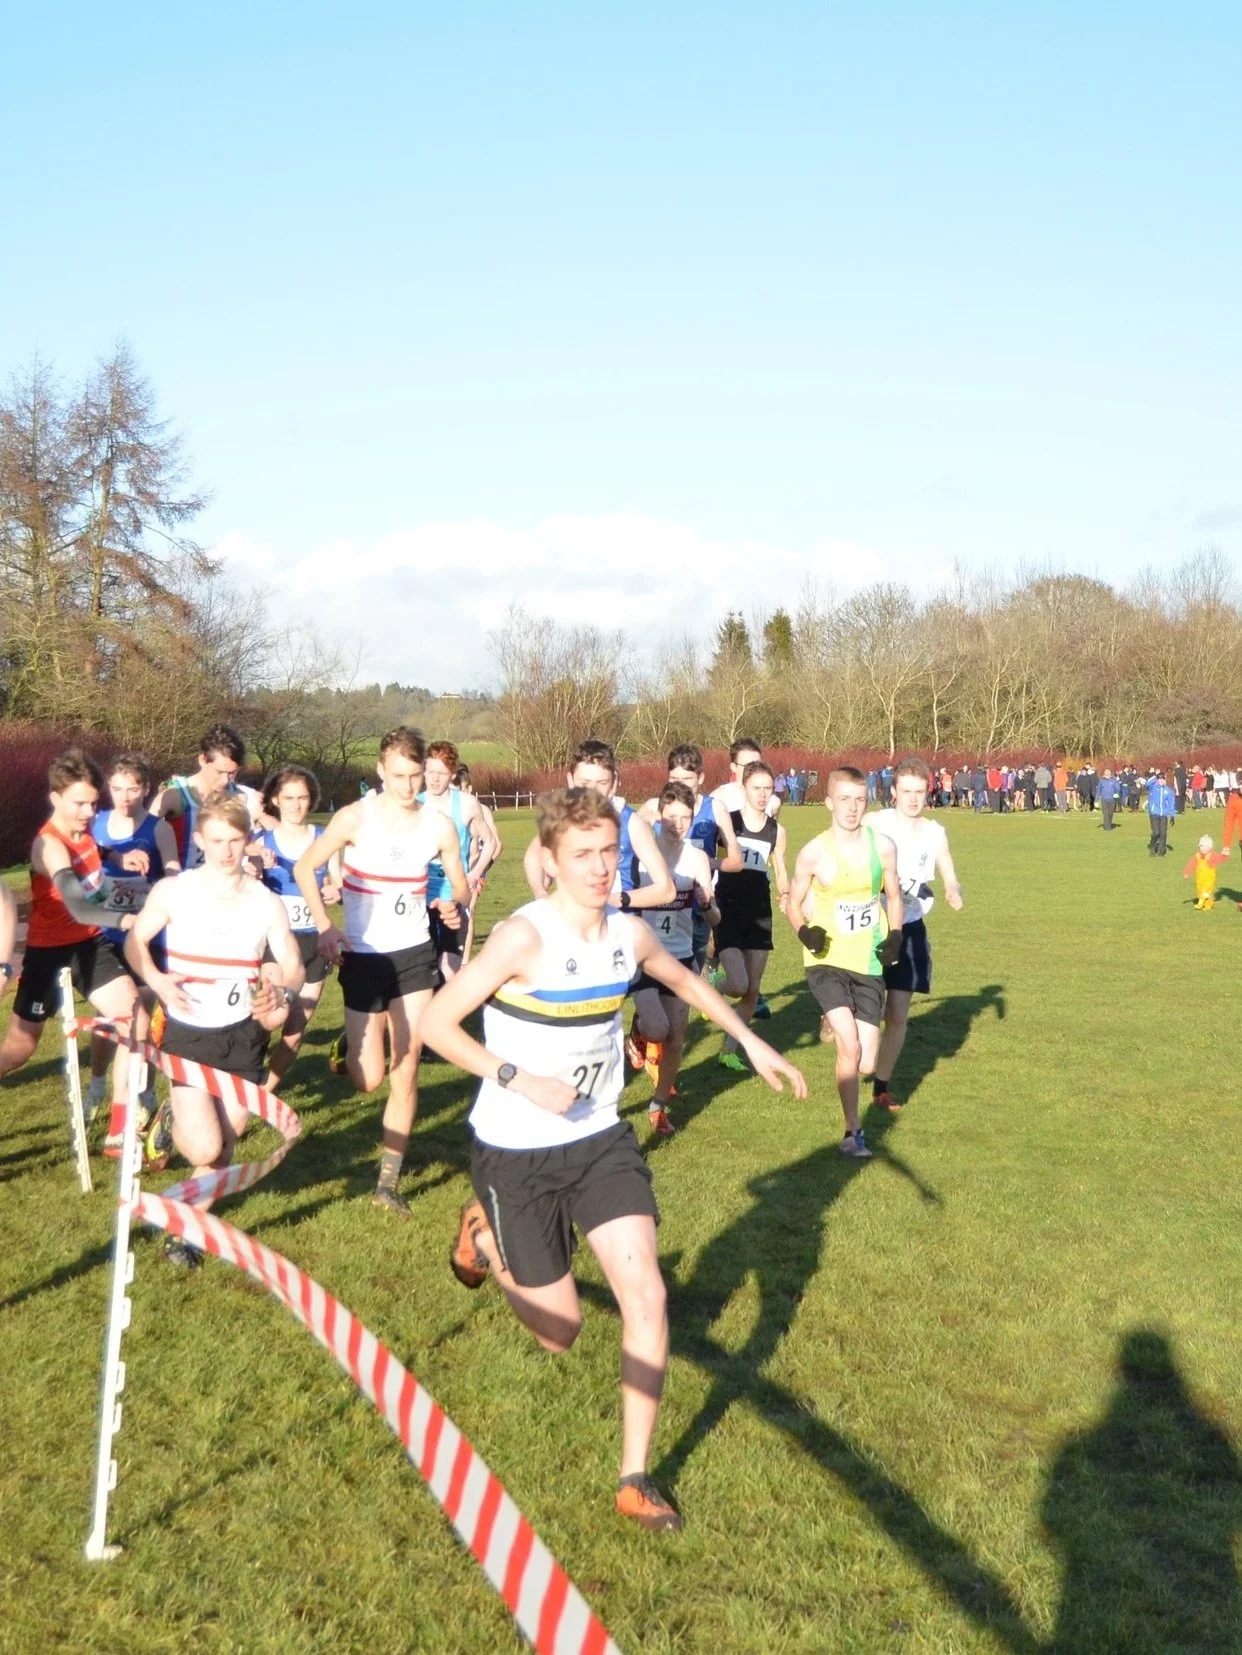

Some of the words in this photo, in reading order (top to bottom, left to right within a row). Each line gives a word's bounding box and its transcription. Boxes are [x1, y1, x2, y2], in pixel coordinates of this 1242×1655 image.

[742, 849, 760, 865] 11
[291, 905, 312, 923] 39
[394, 893, 406, 916] 6
[660, 915, 671, 934] 4
[845, 909, 872, 931] 15
[227, 982, 240, 1007] 6
[573, 1061, 605, 1100] 27
